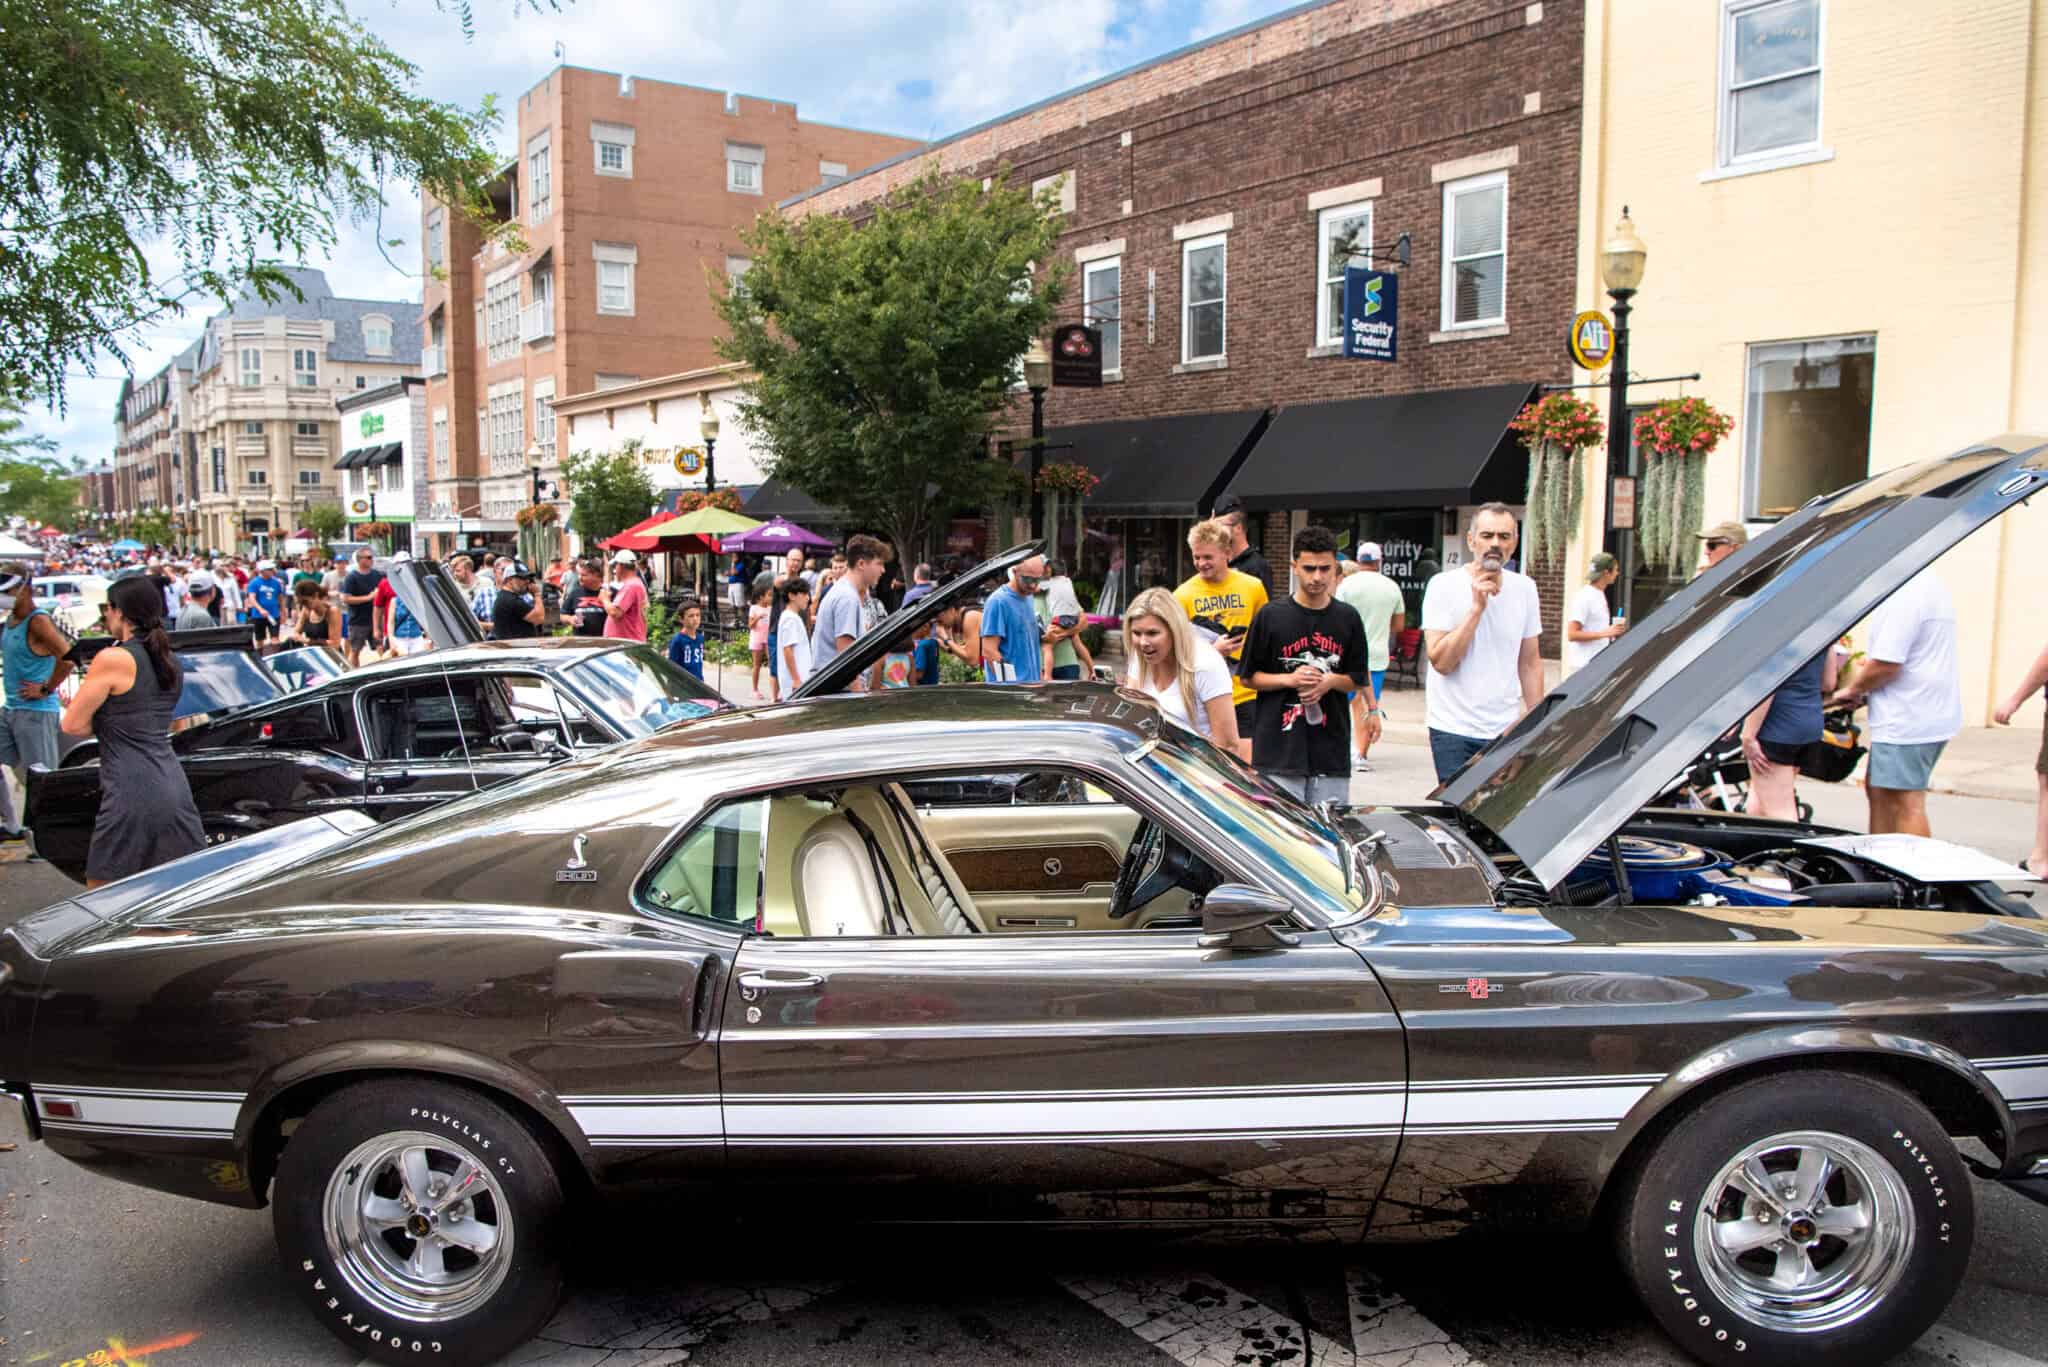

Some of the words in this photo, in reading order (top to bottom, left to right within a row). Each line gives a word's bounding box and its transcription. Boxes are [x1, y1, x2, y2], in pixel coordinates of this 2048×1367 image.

[1351, 318, 1393, 338] Security
[1355, 333, 1389, 348] Federal
[1379, 539, 1422, 561] urity
[1379, 560, 1412, 577] eral
[1194, 593, 1246, 613] CARMEL
[411, 1107, 491, 1149] POLYGLAS
[499, 1157, 516, 1174] GT
[1893, 1130, 1948, 1208] POLYGLAS
[1940, 1222, 1950, 1243] GT
[1664, 1199, 1747, 1352] GOODYEAR
[302, 1259, 443, 1353] GOODYEAR
